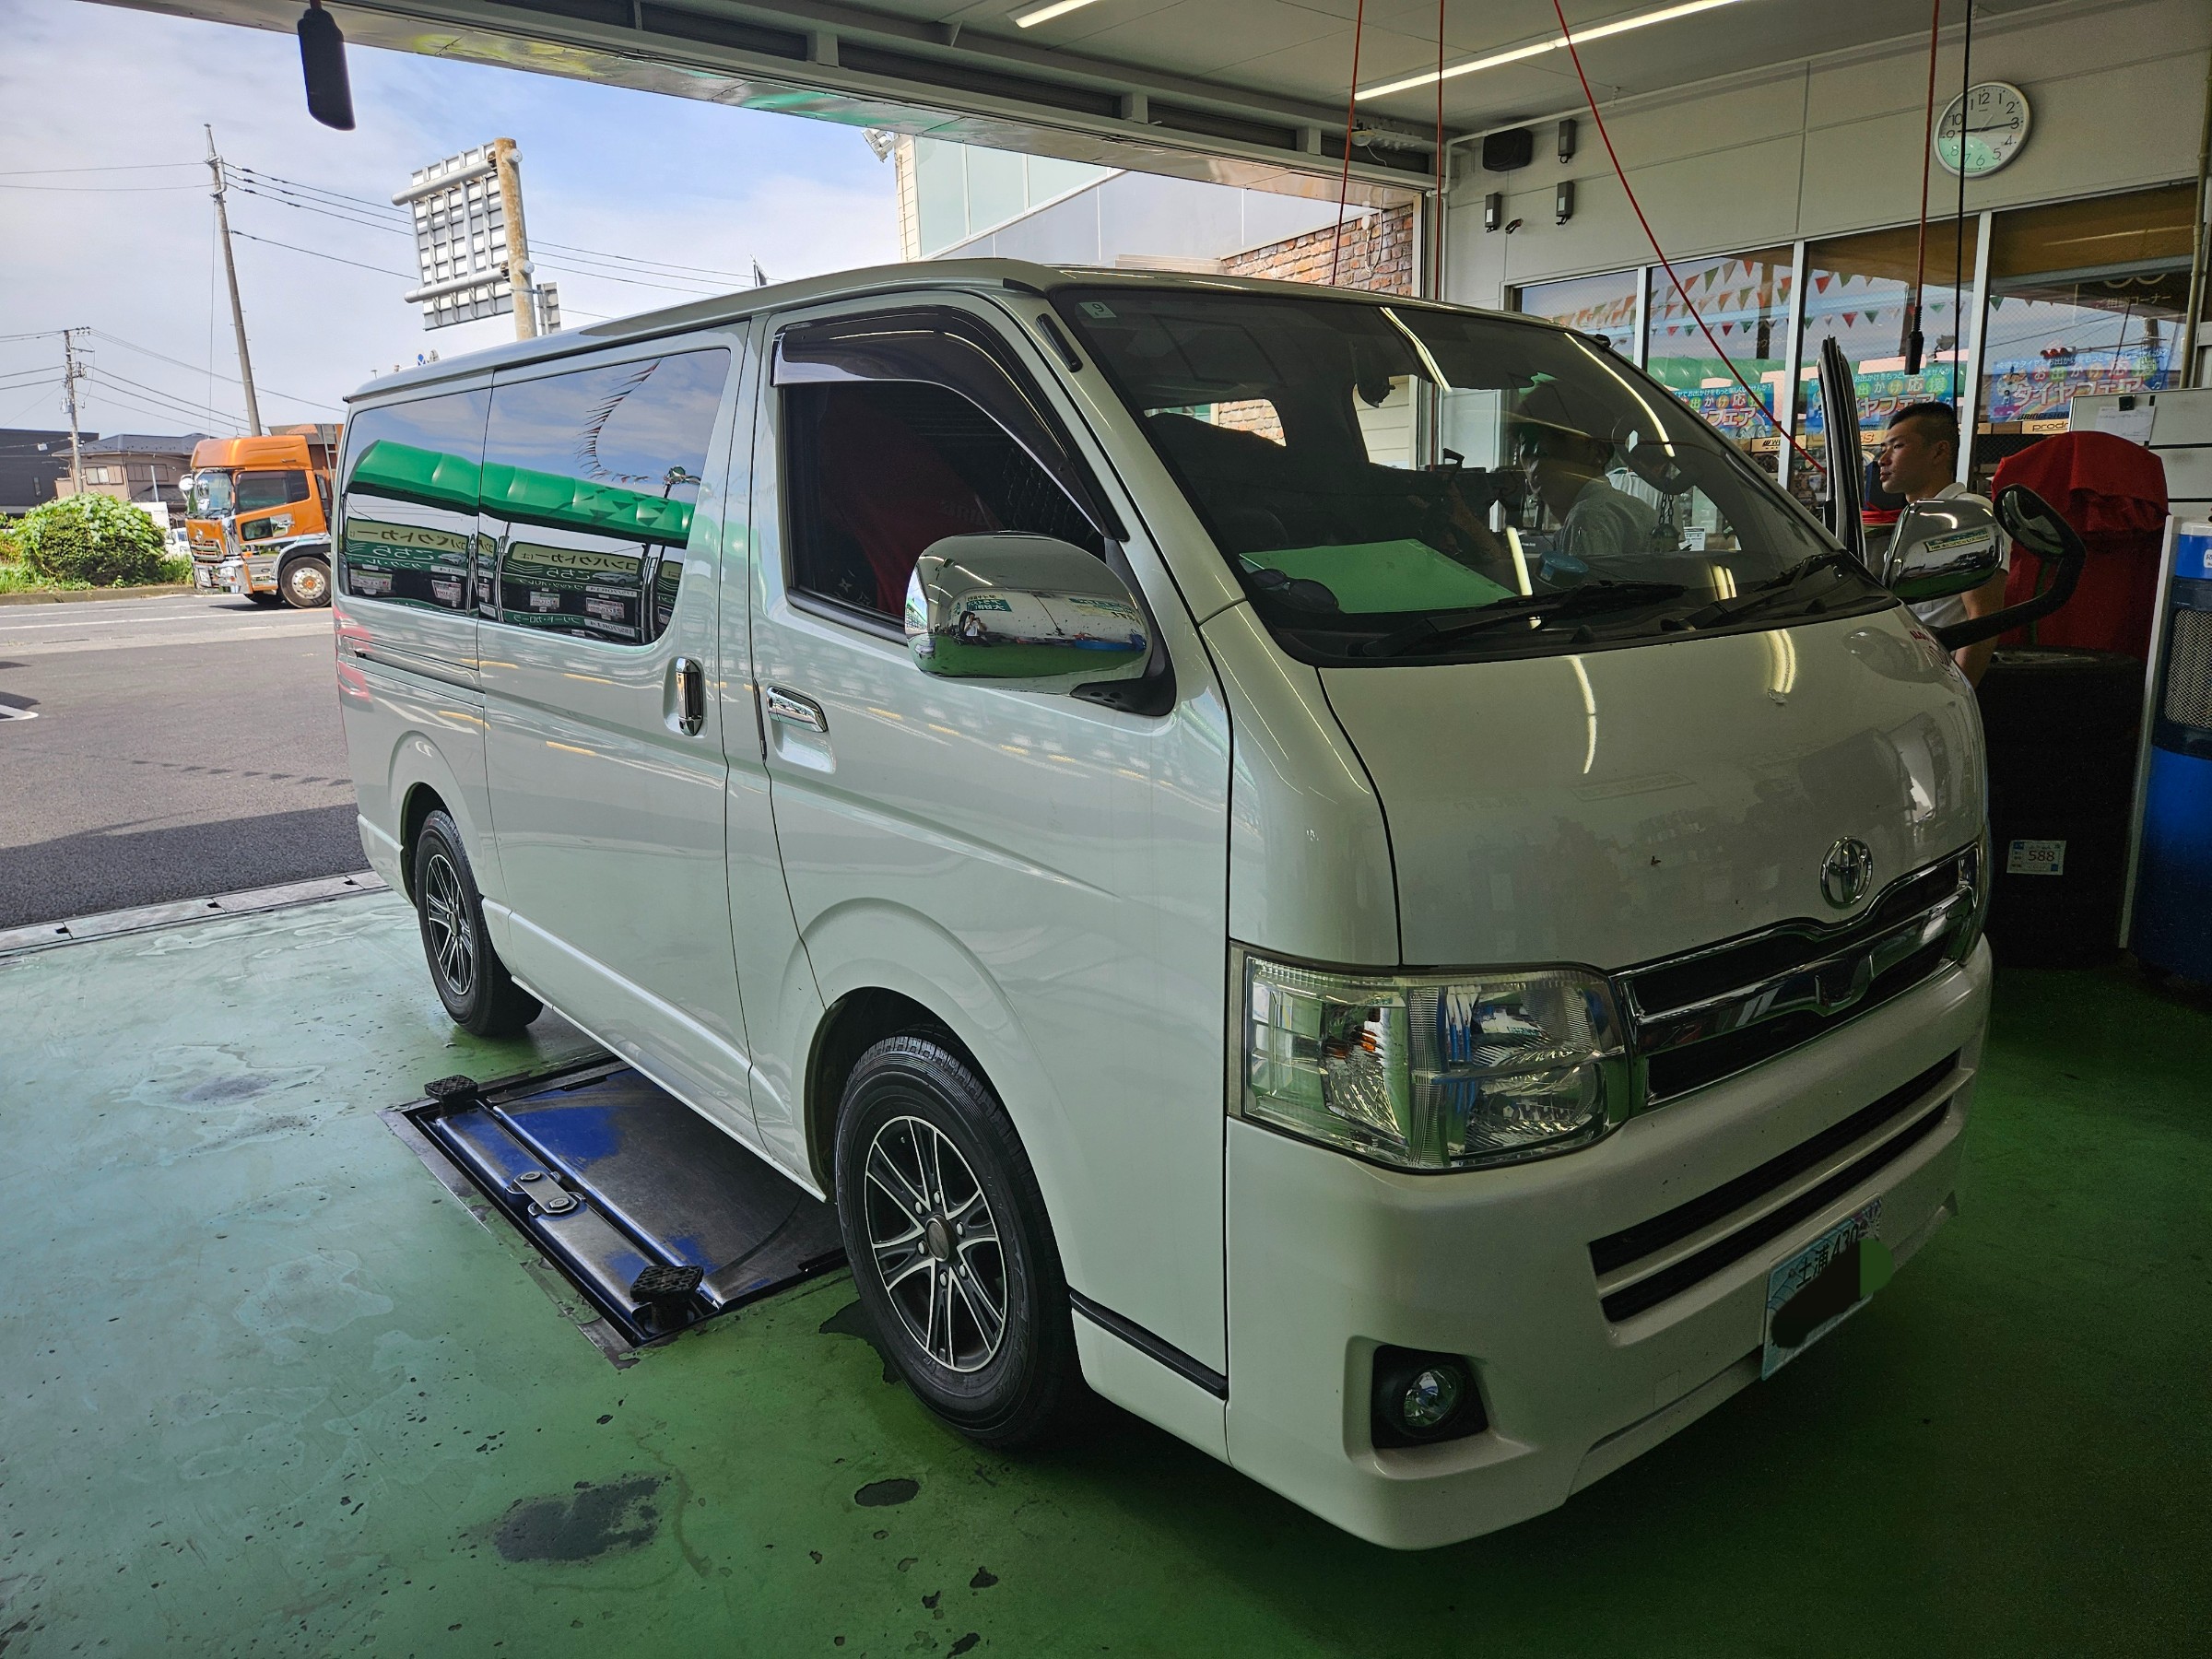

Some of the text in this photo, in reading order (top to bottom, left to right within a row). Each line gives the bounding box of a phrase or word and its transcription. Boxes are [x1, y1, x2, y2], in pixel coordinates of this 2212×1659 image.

[1978, 91, 1990, 105] 12
[2006, 101, 2015, 114] 2
[1951, 112, 1963, 126] 10
[2011, 117, 2020, 129] 3
[1946, 130, 1955, 141] 9
[2005, 135, 2013, 146] 4
[1950, 145, 1959, 157] 8
[1992, 147, 2002, 160] 5
[1976, 155, 1985, 167] 6
[2028, 850, 2055, 862] 588
[1796, 1242, 1830, 1288] 土浦
